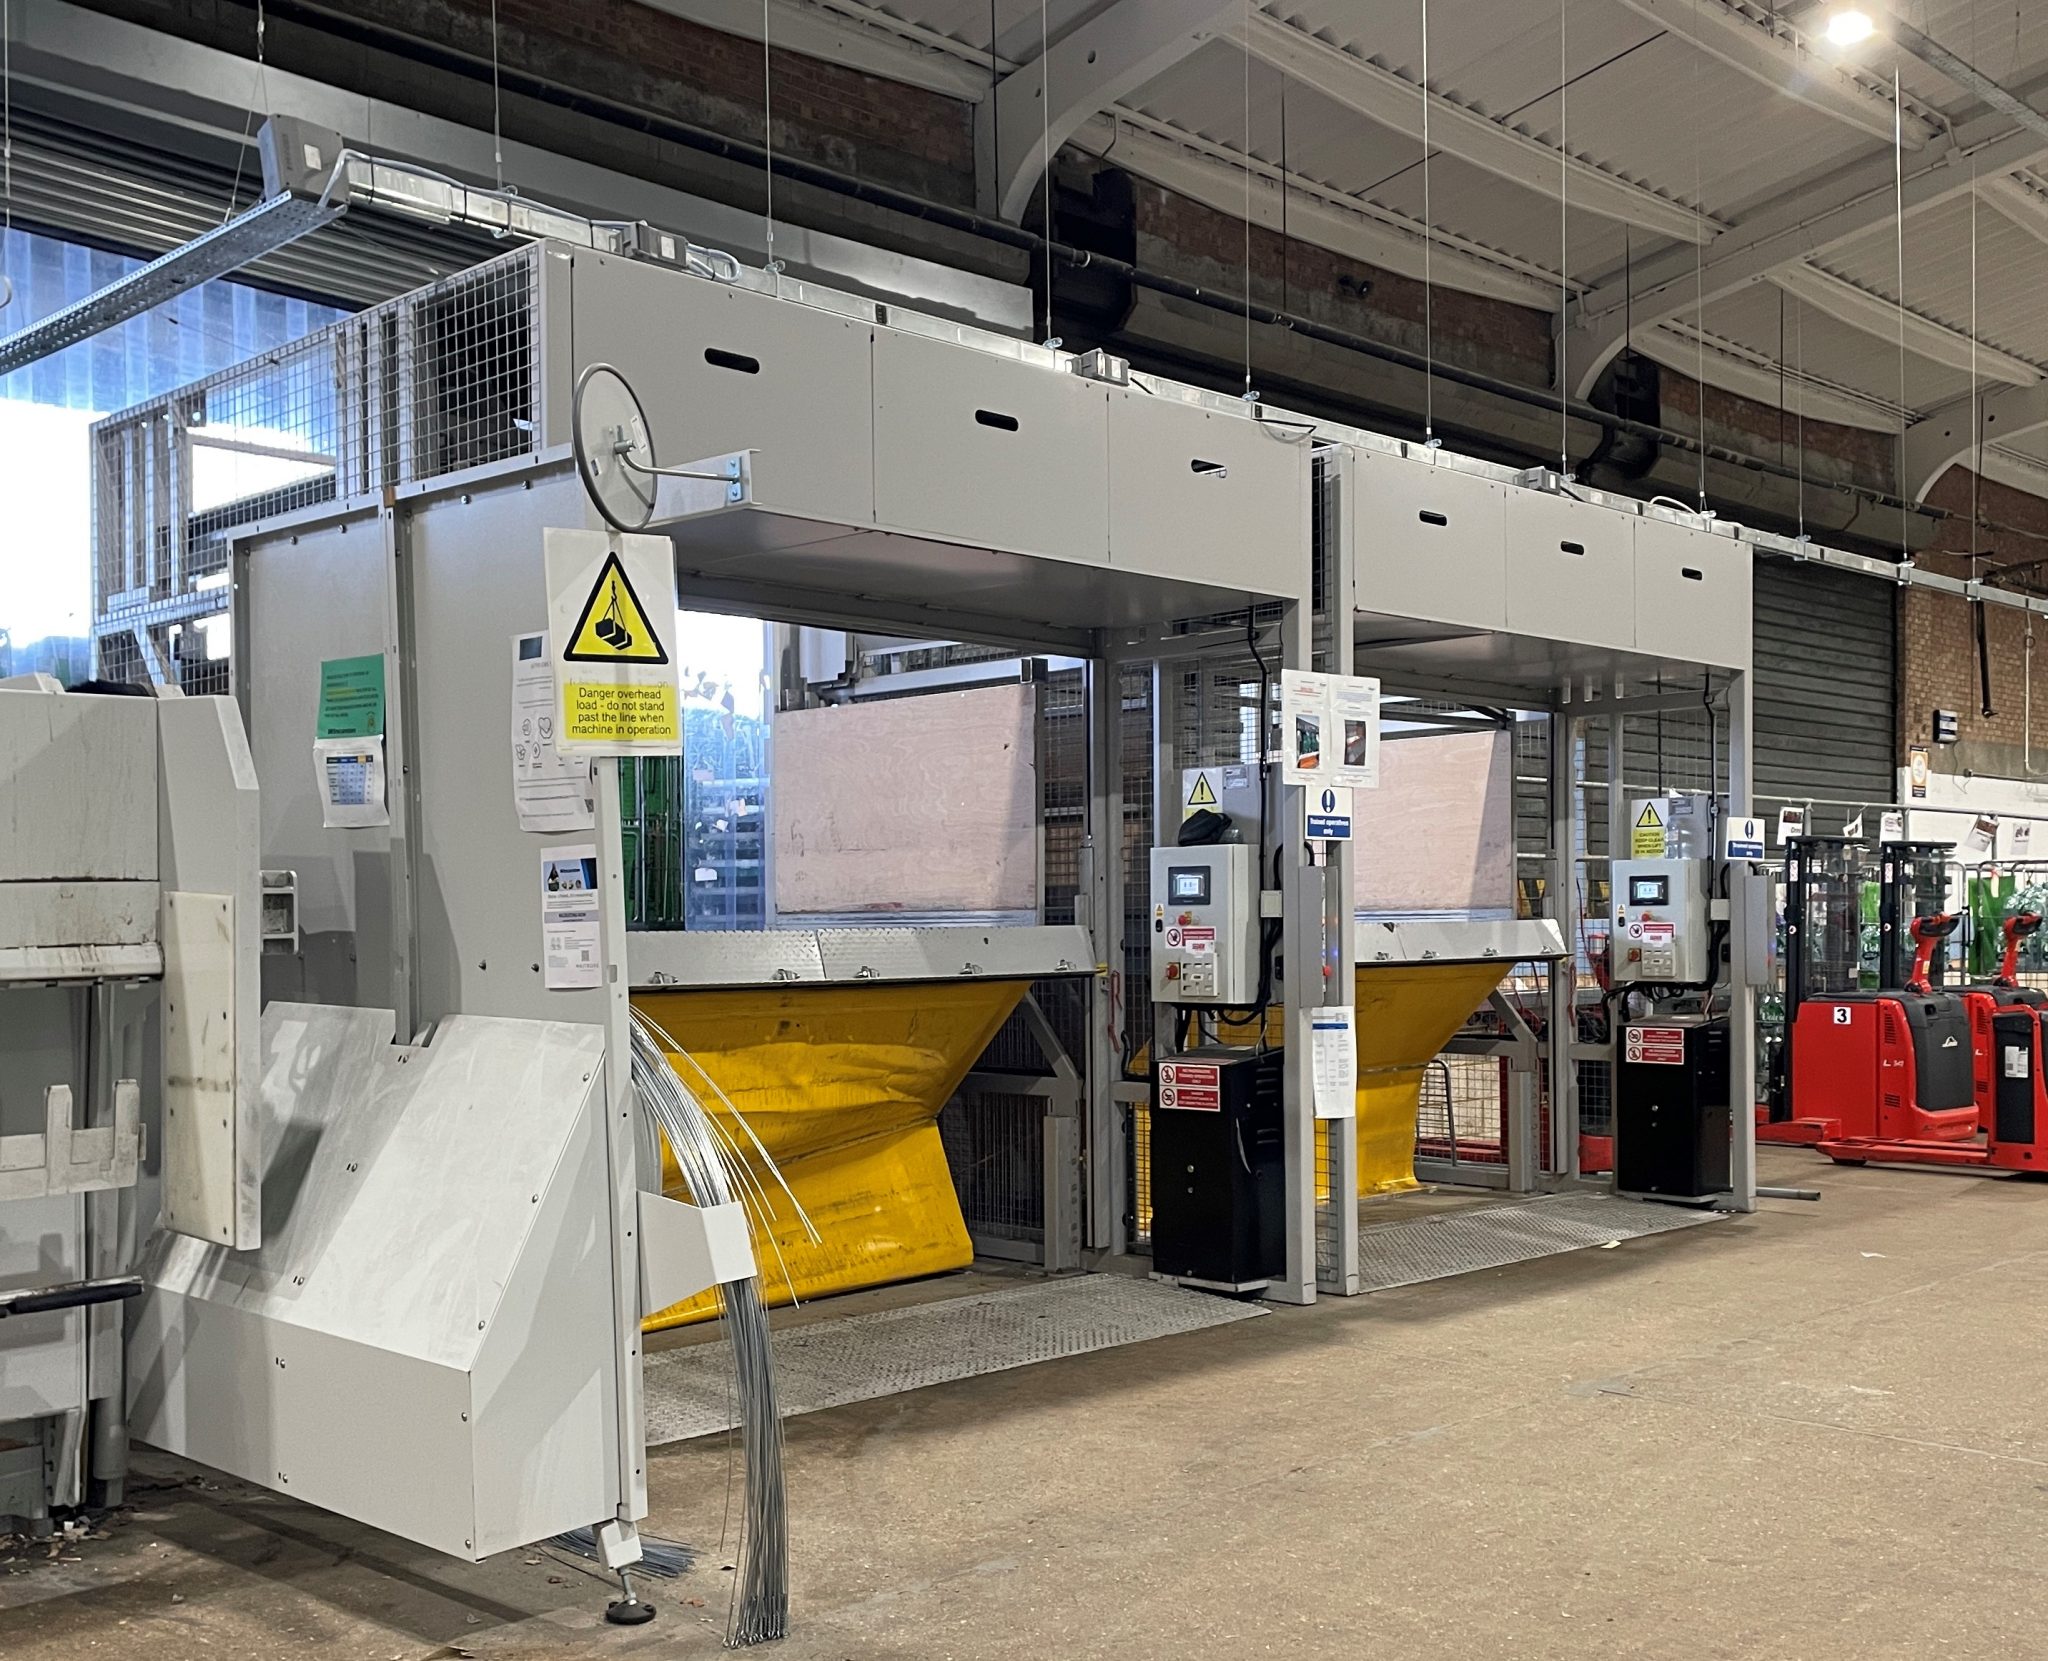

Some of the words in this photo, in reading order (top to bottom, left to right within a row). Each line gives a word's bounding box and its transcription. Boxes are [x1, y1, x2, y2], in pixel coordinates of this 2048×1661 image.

[579, 687, 615, 700] Danger
[617, 689, 661, 699] overhead
[576, 700, 597, 710] load
[607, 701, 619, 711] do
[622, 701, 637, 711] not
[639, 702, 665, 711] stand
[578, 713, 599, 724] past
[602, 713, 617, 722] the
[619, 713, 637, 722] line
[639, 713, 664, 723] when
[572, 724, 613, 734] machine
[616, 725, 624, 734] in
[627, 725, 671, 736] operation
[1836, 1009, 1848, 1023] 3
